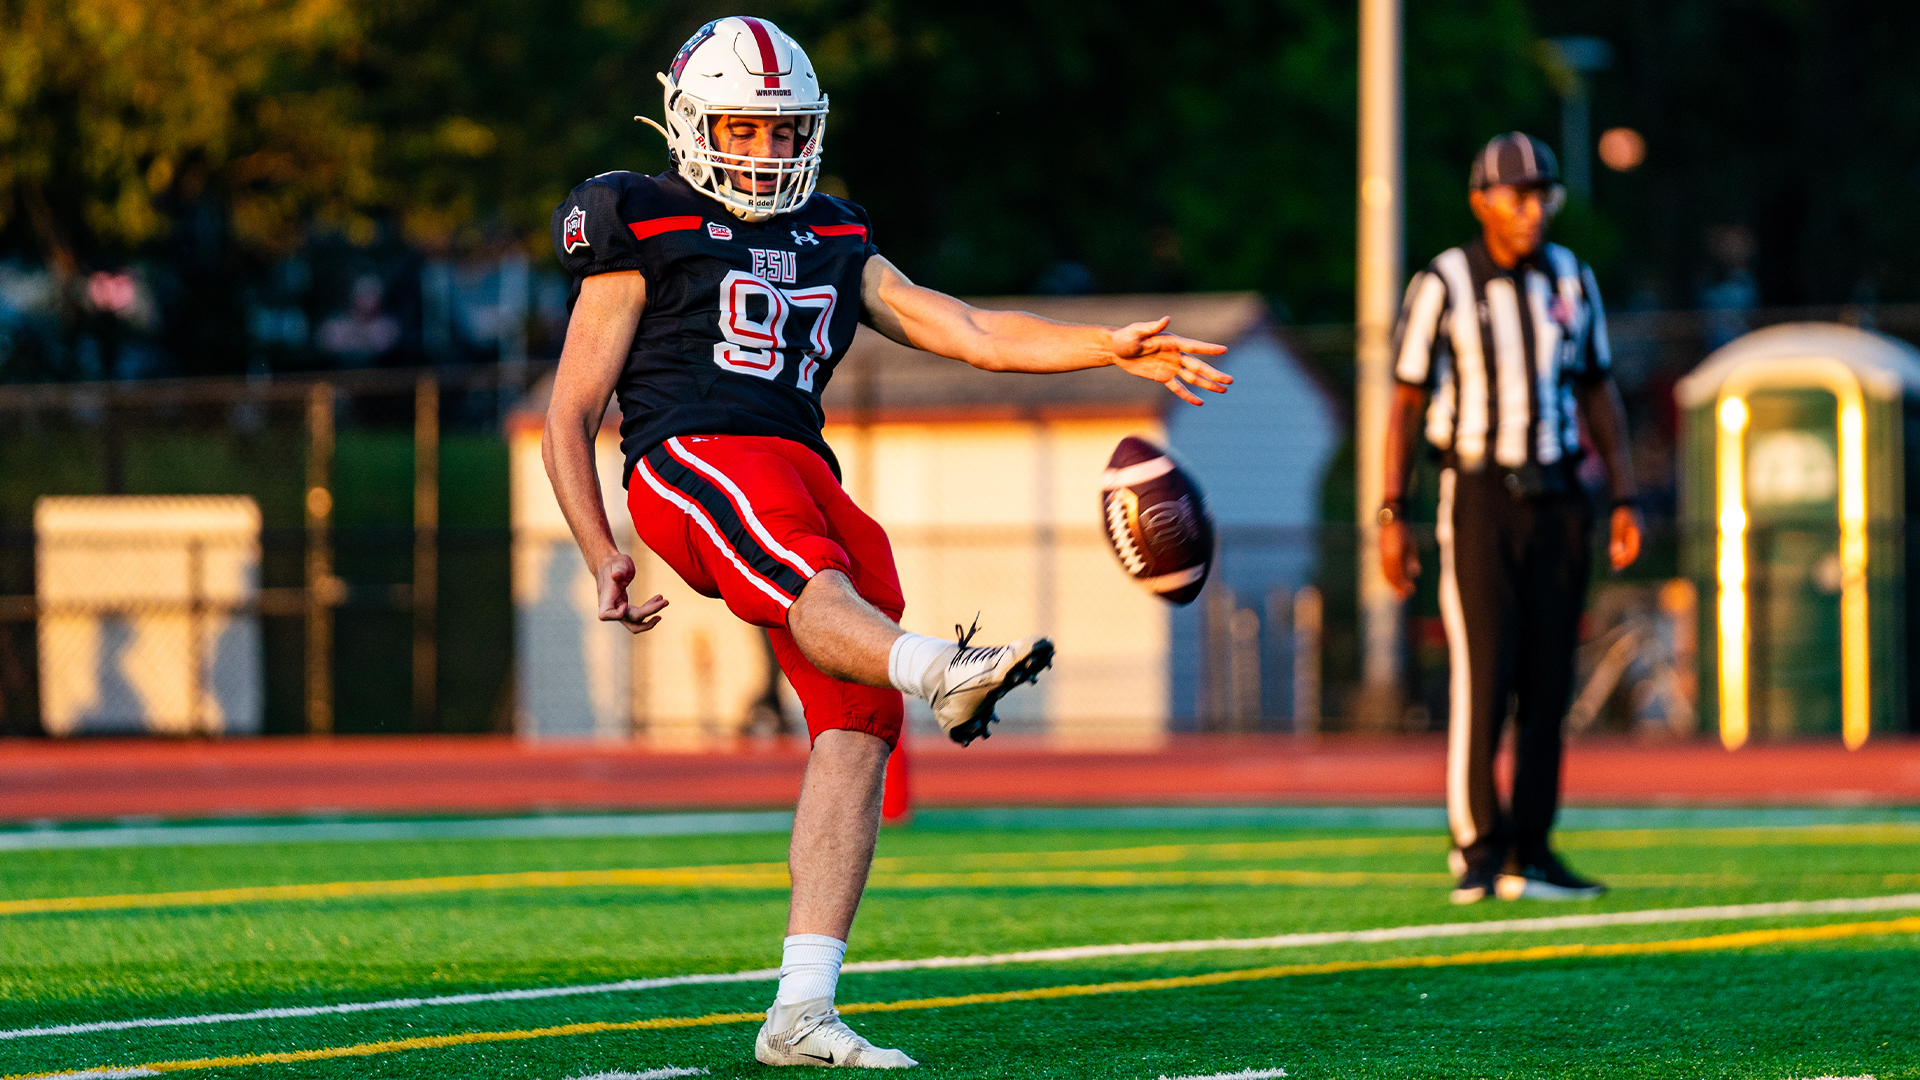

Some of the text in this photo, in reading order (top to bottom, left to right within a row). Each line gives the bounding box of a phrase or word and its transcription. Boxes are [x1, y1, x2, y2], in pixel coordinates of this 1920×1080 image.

[756, 89, 792, 97] WARRIORS
[748, 248, 797, 284] ESU
[713, 269, 838, 393] 97
